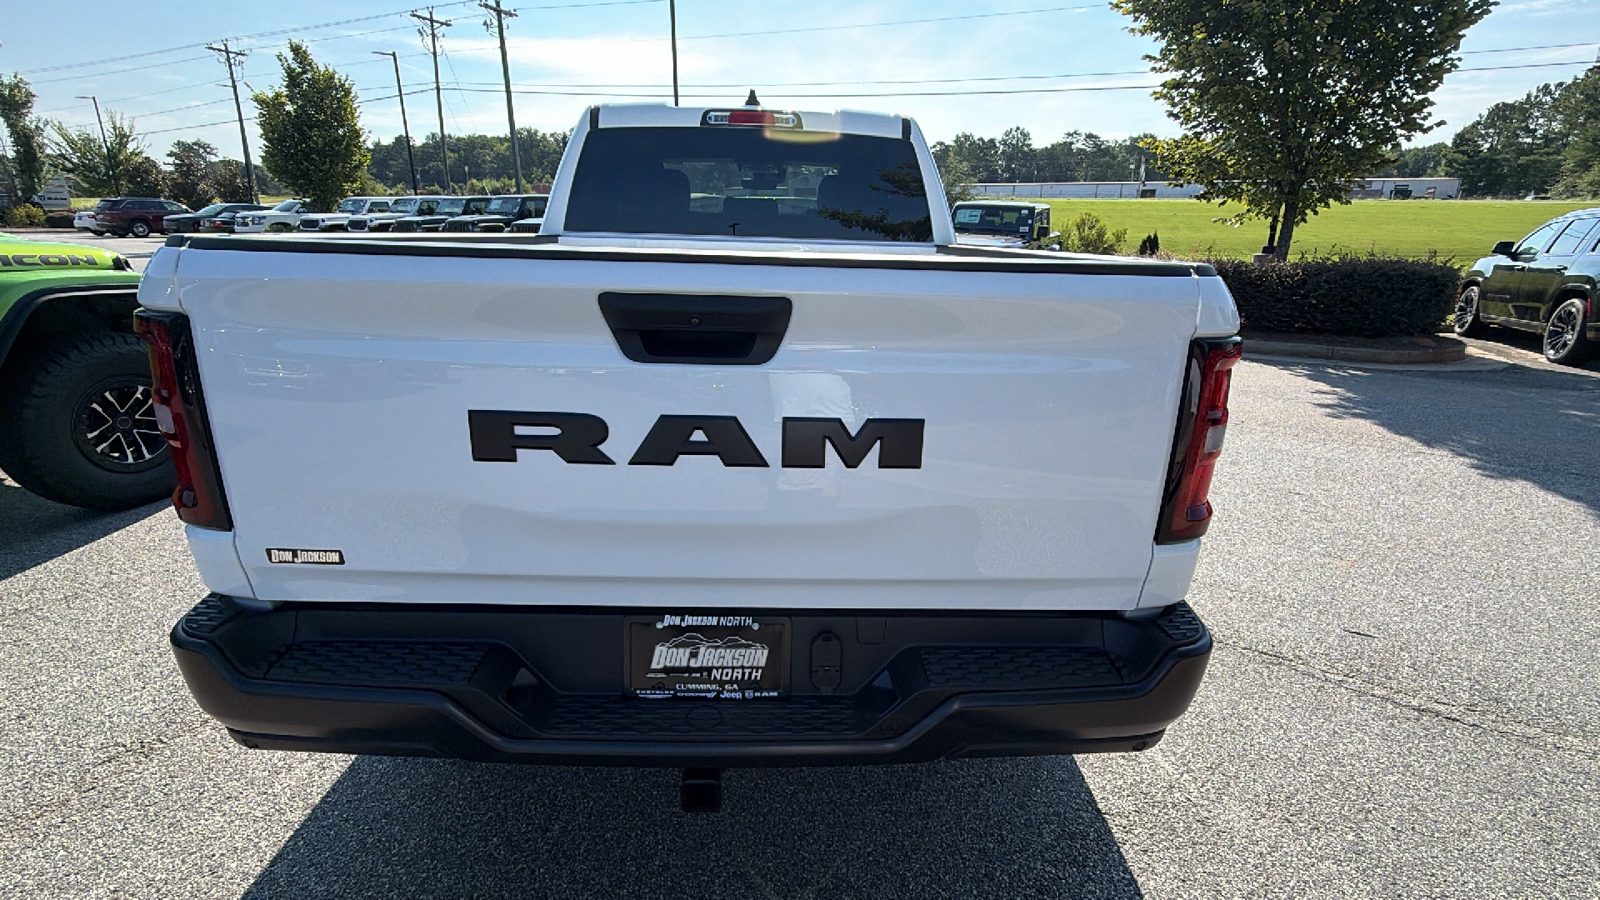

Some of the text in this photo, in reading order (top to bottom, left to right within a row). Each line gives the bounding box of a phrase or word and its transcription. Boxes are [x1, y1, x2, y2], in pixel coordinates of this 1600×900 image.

[468, 409, 924, 469] RAM
[271, 550, 340, 563] DON JACKSON
[663, 614, 752, 627] DON JACKSON NORTH
[650, 645, 769, 669] DON JACKSON
[711, 668, 762, 680] NORTH
[720, 691, 742, 699] Jeep
